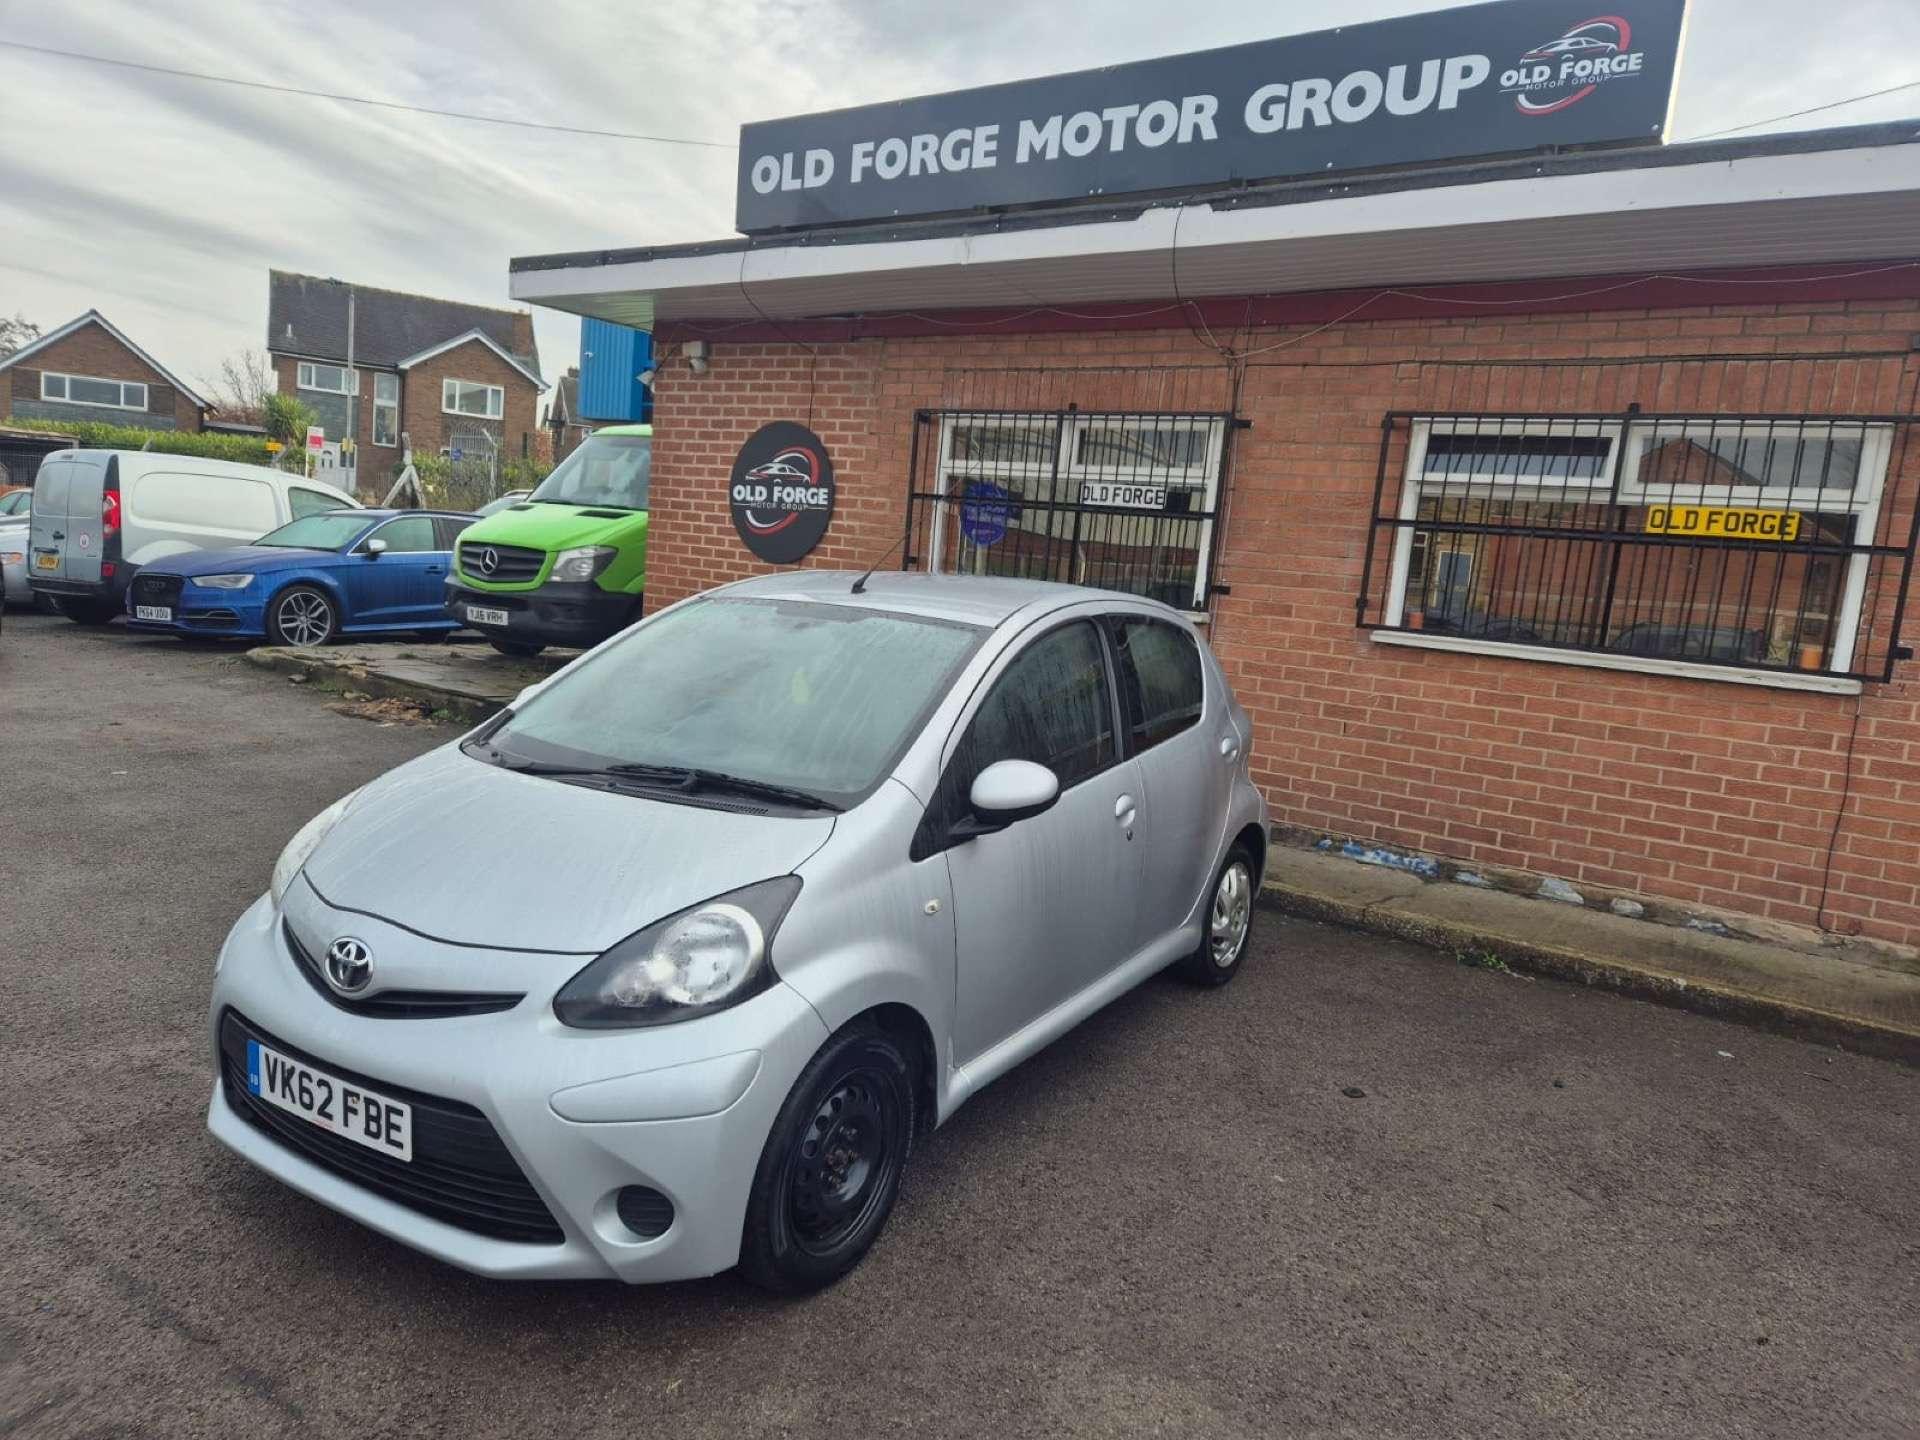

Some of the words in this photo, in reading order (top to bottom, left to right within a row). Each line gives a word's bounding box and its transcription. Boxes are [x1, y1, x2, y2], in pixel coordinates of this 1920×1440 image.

[1500, 65, 1551, 87] OLD
[1559, 52, 1644, 80] FORGE
[1524, 81, 1565, 91] MOTOR
[1571, 73, 1613, 85] GROUP
[750, 148, 835, 195] OLD
[850, 124, 1000, 183] FORGE
[1015, 94, 1219, 165] MOTOR
[1244, 54, 1491, 134] GROUP
[733, 484, 768, 502] OLD
[773, 486, 829, 505] FORGE
[1081, 485, 1109, 502] OLD
[1112, 487, 1166, 506] FORGE
[781, 503, 809, 511] GROUP
[1650, 508, 1699, 530] OLD
[1704, 511, 1796, 536] FORGE
[264, 1052, 334, 1122] VK62
[342, 1087, 404, 1152] FBE
